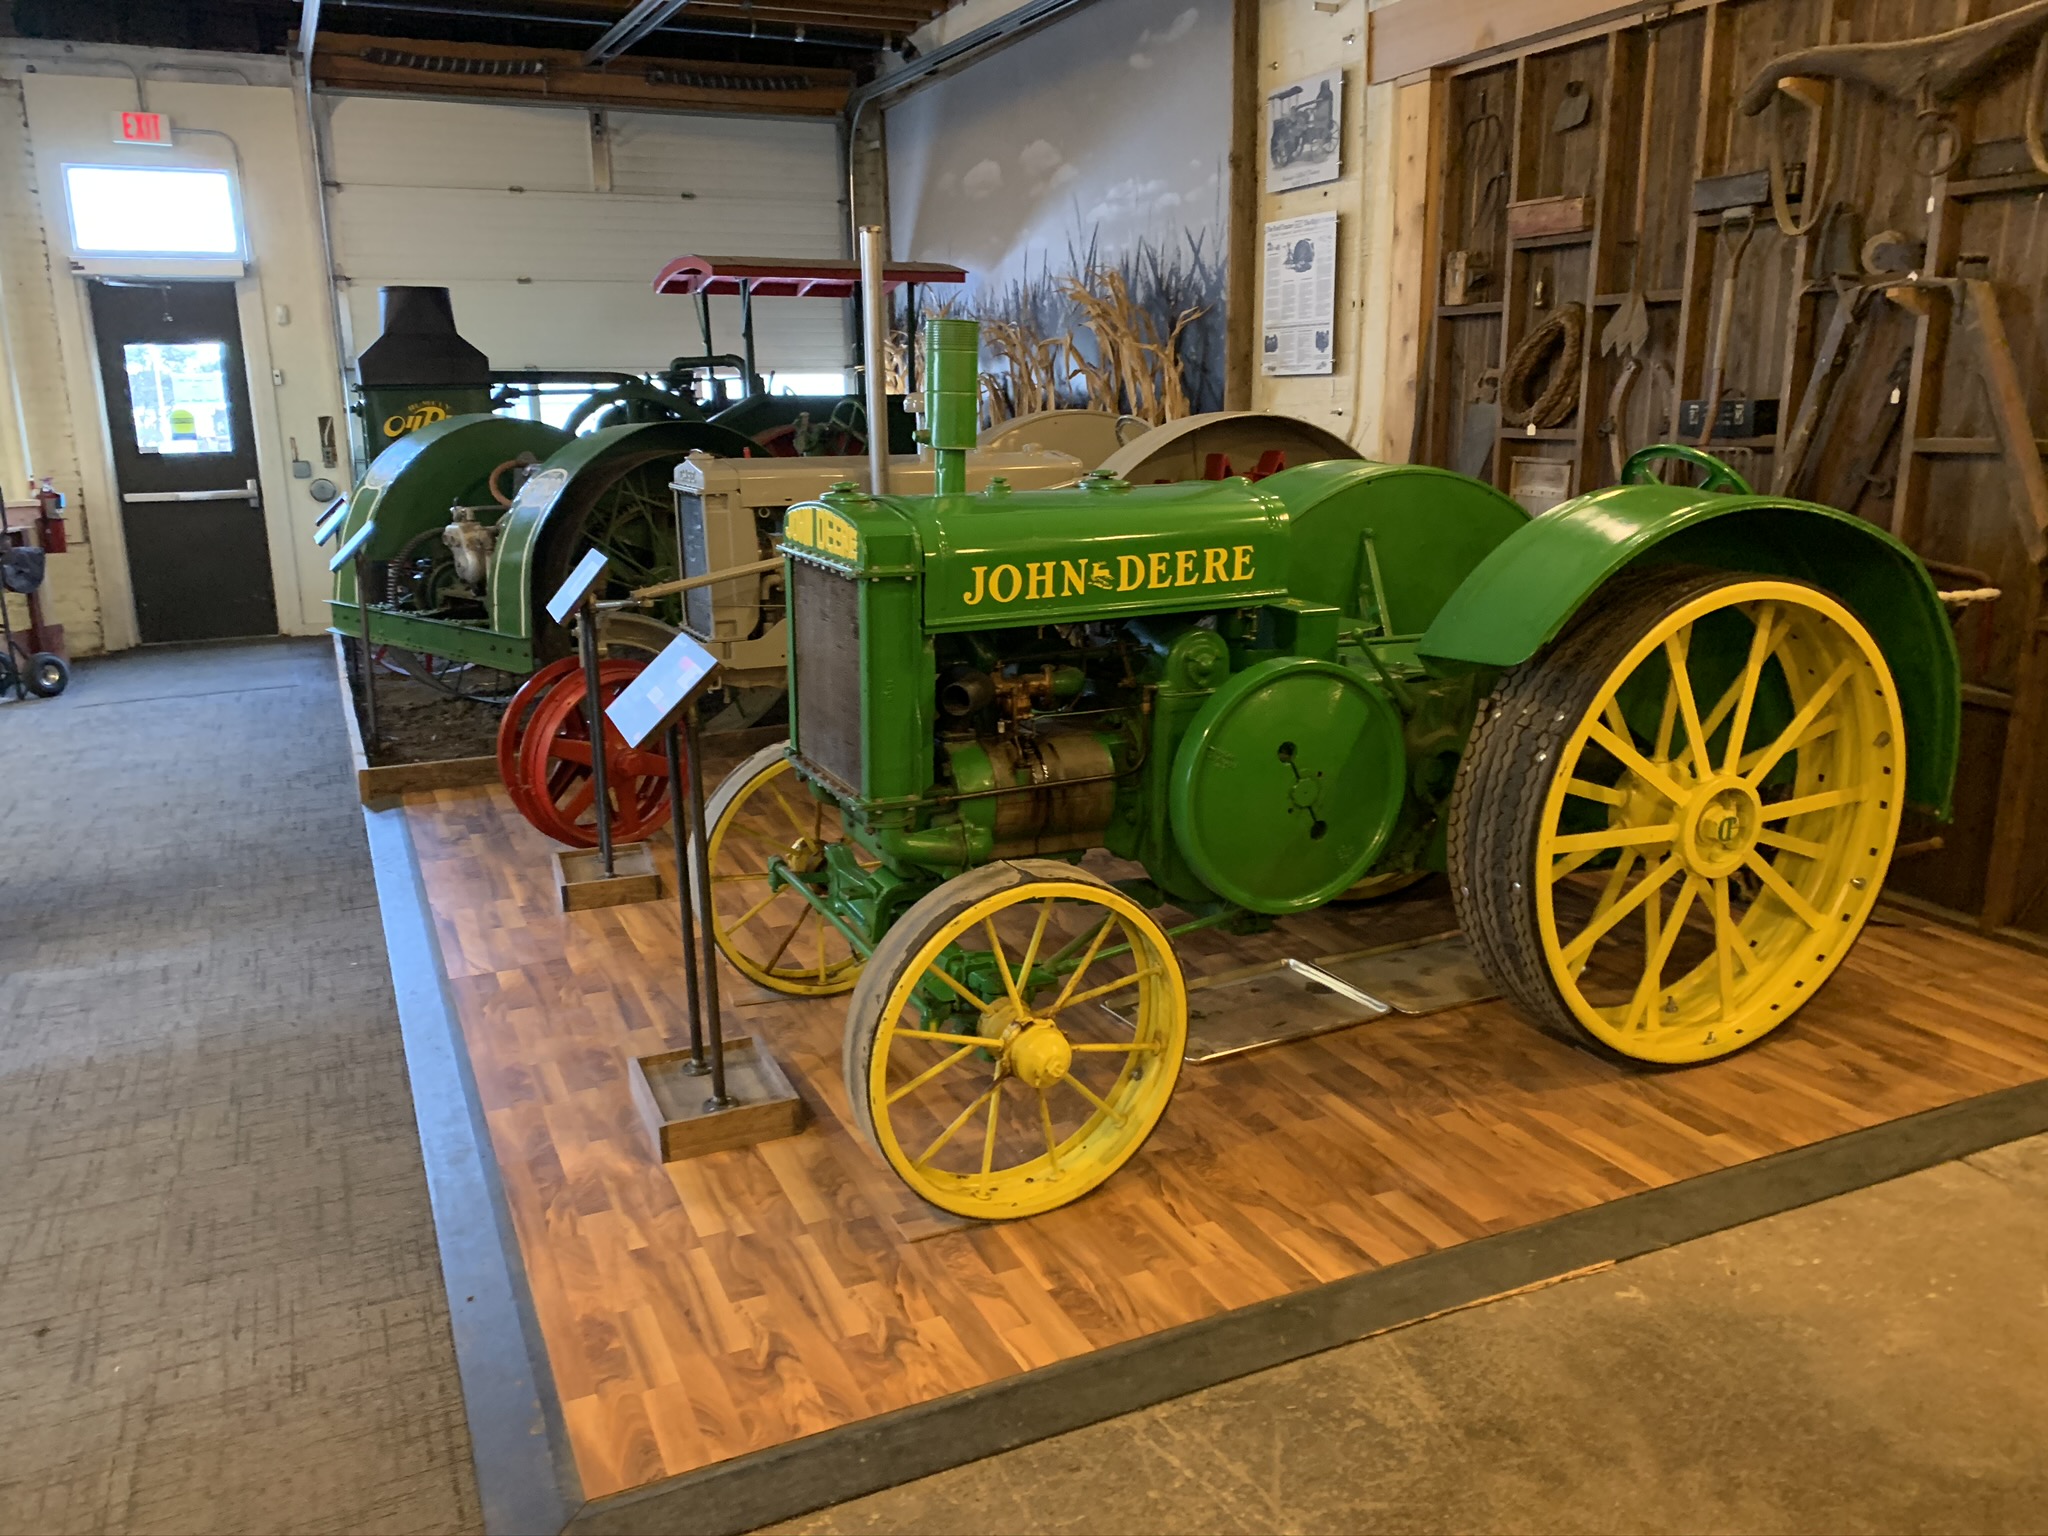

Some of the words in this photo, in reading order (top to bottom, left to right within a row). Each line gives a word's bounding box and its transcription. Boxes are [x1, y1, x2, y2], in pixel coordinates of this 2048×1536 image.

[122, 111, 160, 141] EXIT
[963, 558, 1088, 605] JOHN
[1116, 545, 1254, 592] DEERE
